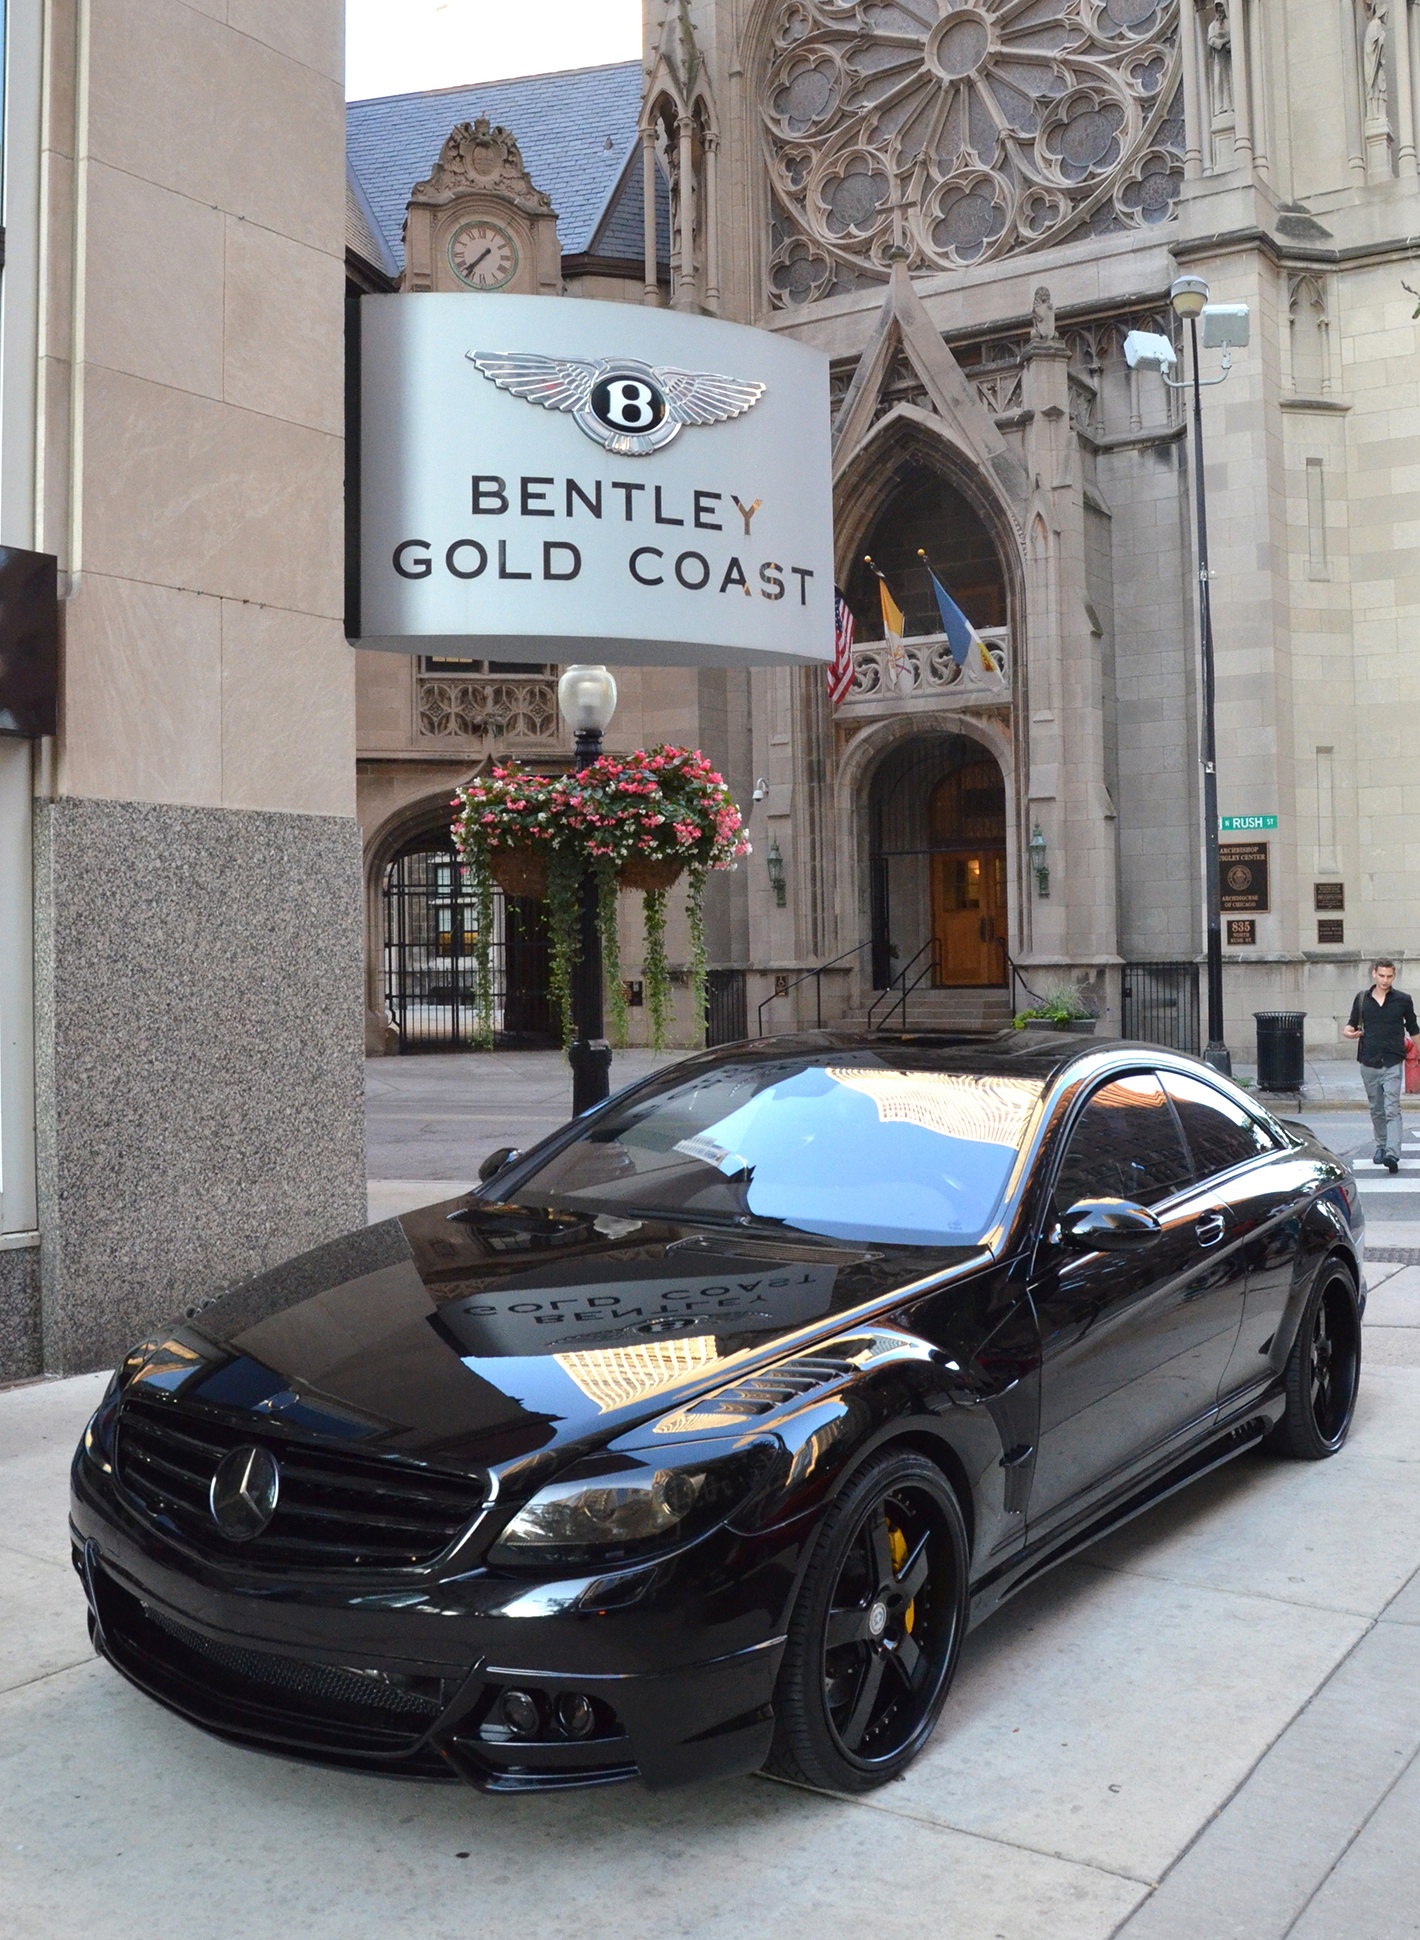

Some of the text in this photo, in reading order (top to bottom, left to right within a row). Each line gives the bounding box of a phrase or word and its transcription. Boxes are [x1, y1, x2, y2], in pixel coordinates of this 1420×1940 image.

[471, 475, 764, 536] BENTLEY
[392, 538, 814, 606] GOLD COAST
[1232, 817, 1262, 828] RUSH
[1232, 922, 1250, 932] 835
